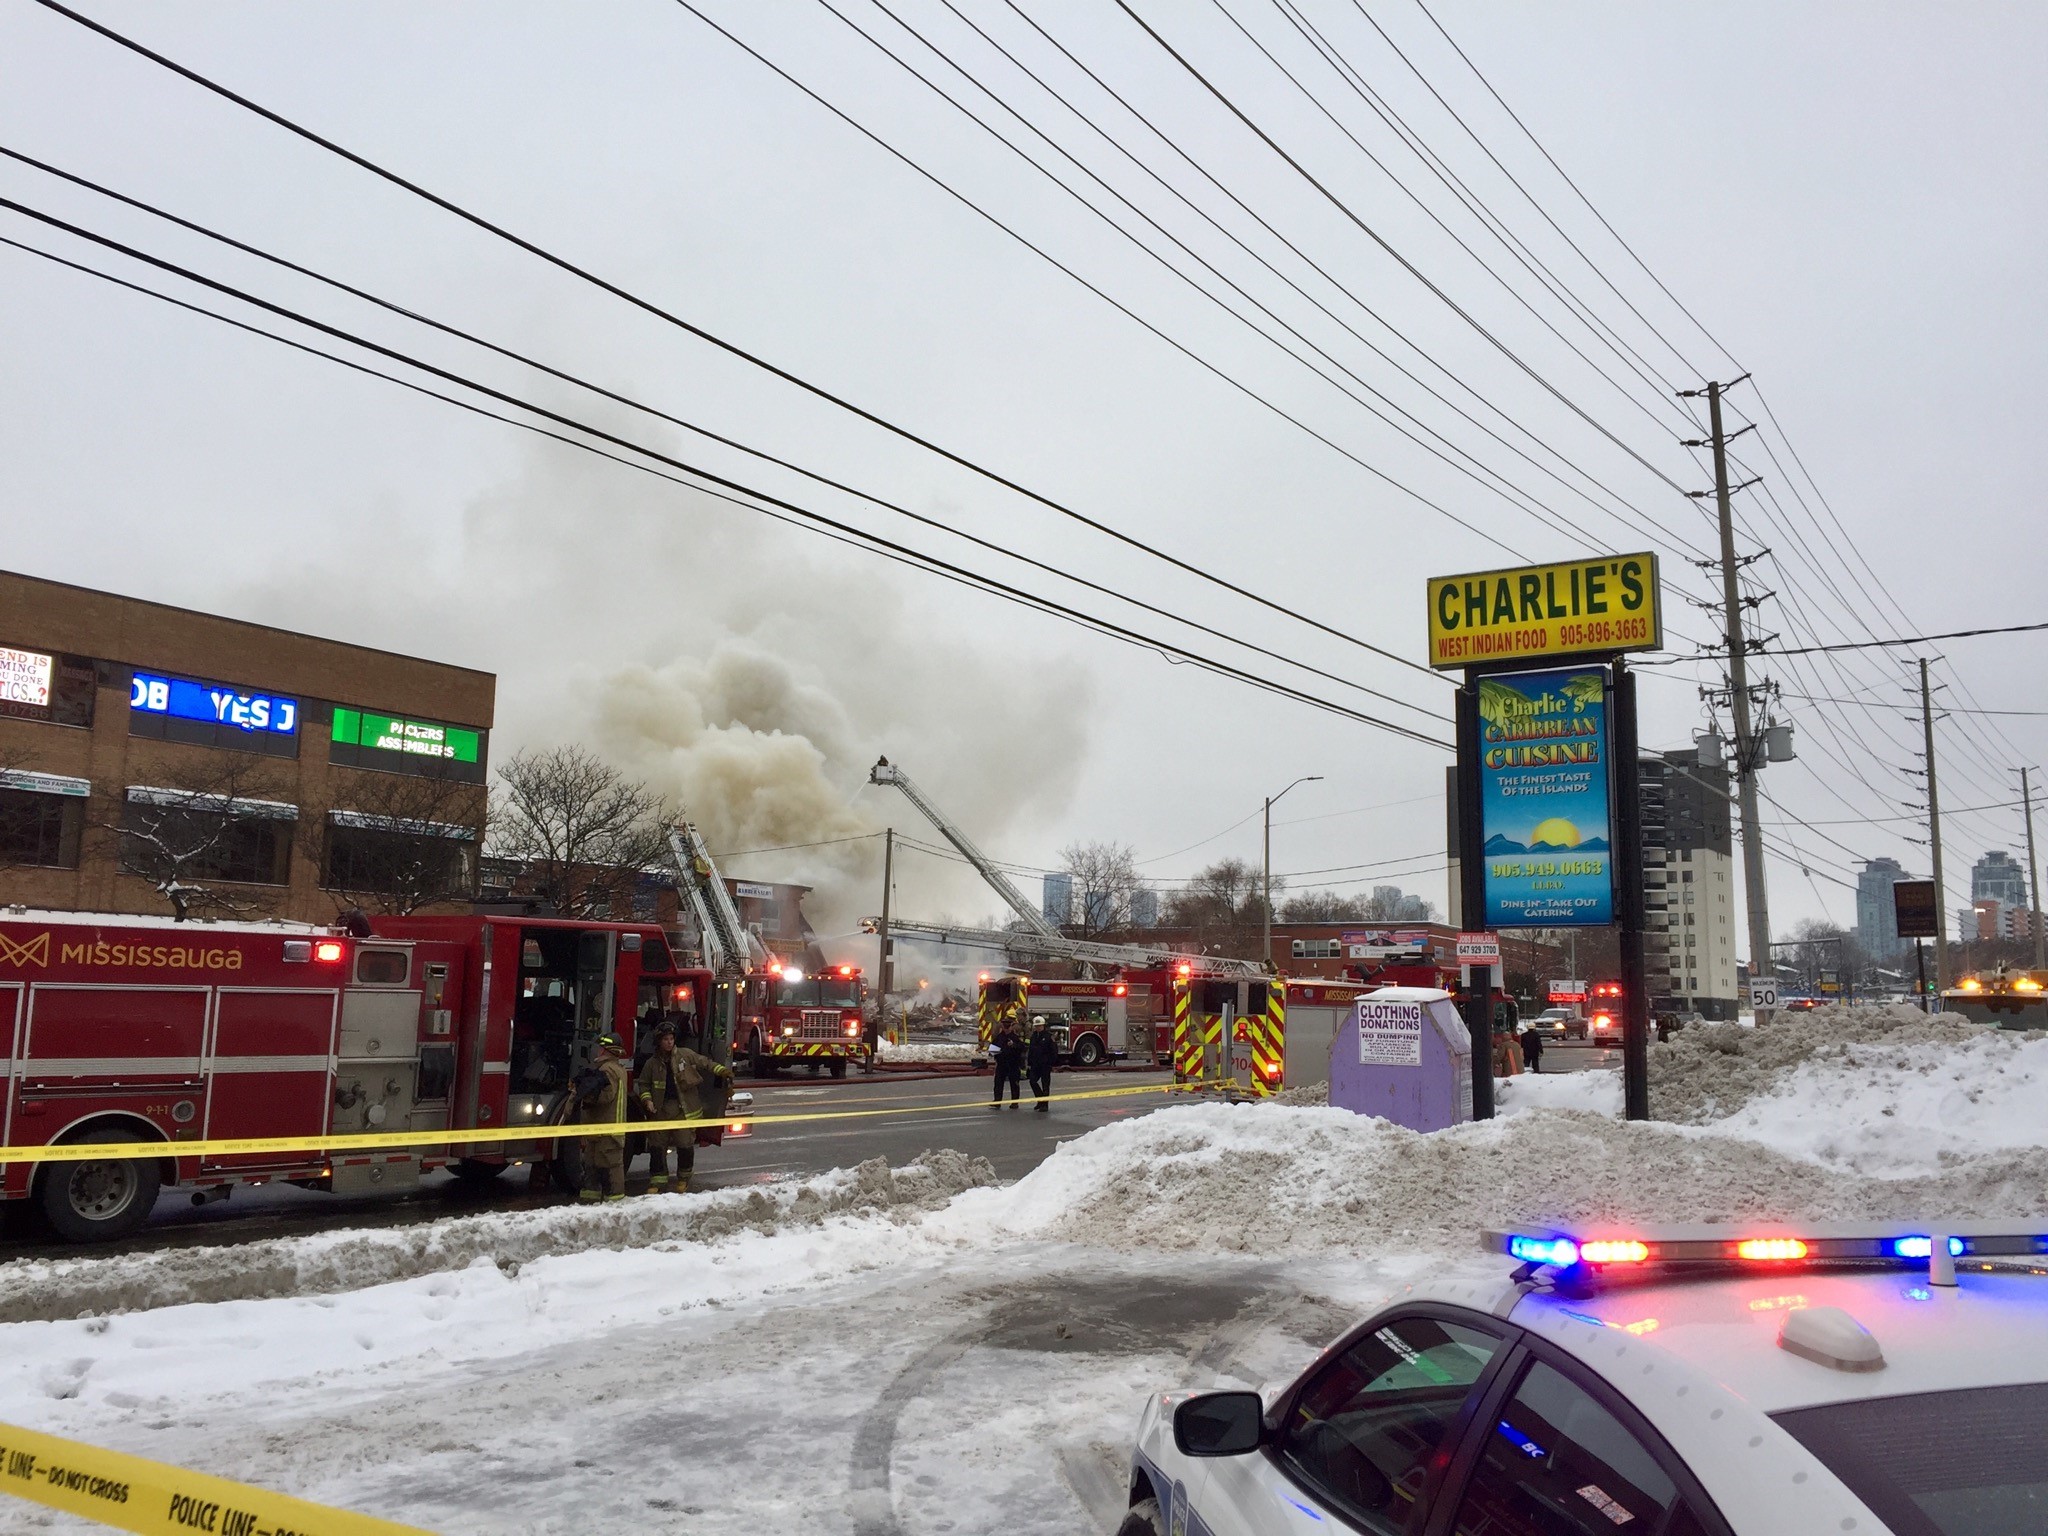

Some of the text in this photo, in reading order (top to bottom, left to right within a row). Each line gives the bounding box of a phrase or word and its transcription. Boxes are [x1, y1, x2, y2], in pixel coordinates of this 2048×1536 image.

[1438, 561, 1643, 630] CHARLIE'S
[1438, 617, 1646, 658] WEST INDIAN FOOD 905-896-3663
[33, 656, 48, 667] IS
[14, 673, 43, 685] DONE
[211, 692, 271, 729] YES
[277, 703, 295, 730] J
[1501, 692, 1585, 719] Charlie's
[1485, 716, 1598, 743] CARIBBEAN
[377, 735, 455, 758] ASSEMBLERS
[1485, 740, 1599, 770] CUISINE
[1497, 772, 1591, 786] THE FINEST TASTE
[1502, 783, 1588, 796] OF THE ISLANDS
[1501, 900, 1526, 908] DINE
[1546, 898, 1573, 908] TAKE
[1574, 898, 1598, 907] OUT
[1523, 908, 1574, 918] CATERING
[1459, 945, 1470, 954] 647
[1470, 945, 1482, 954] 929
[1060, 986, 1097, 994] MISSISSAUGA
[1324, 990, 1363, 1001] MISSISSAU
[1753, 990, 1775, 1006] 50
[1360, 1005, 1419, 1020] CLOTHING
[1360, 1019, 1420, 1031] DONATIONS
[146, 1105, 169, 1115] 9-1-1
[8, 1450, 36, 1480] LINE
[48, 1465, 65, 1487] DO
[65, 1469, 91, 1493] NOT
[89, 1475, 130, 1504] CROSS
[168, 1493, 258, 1536] POLICE LINE
